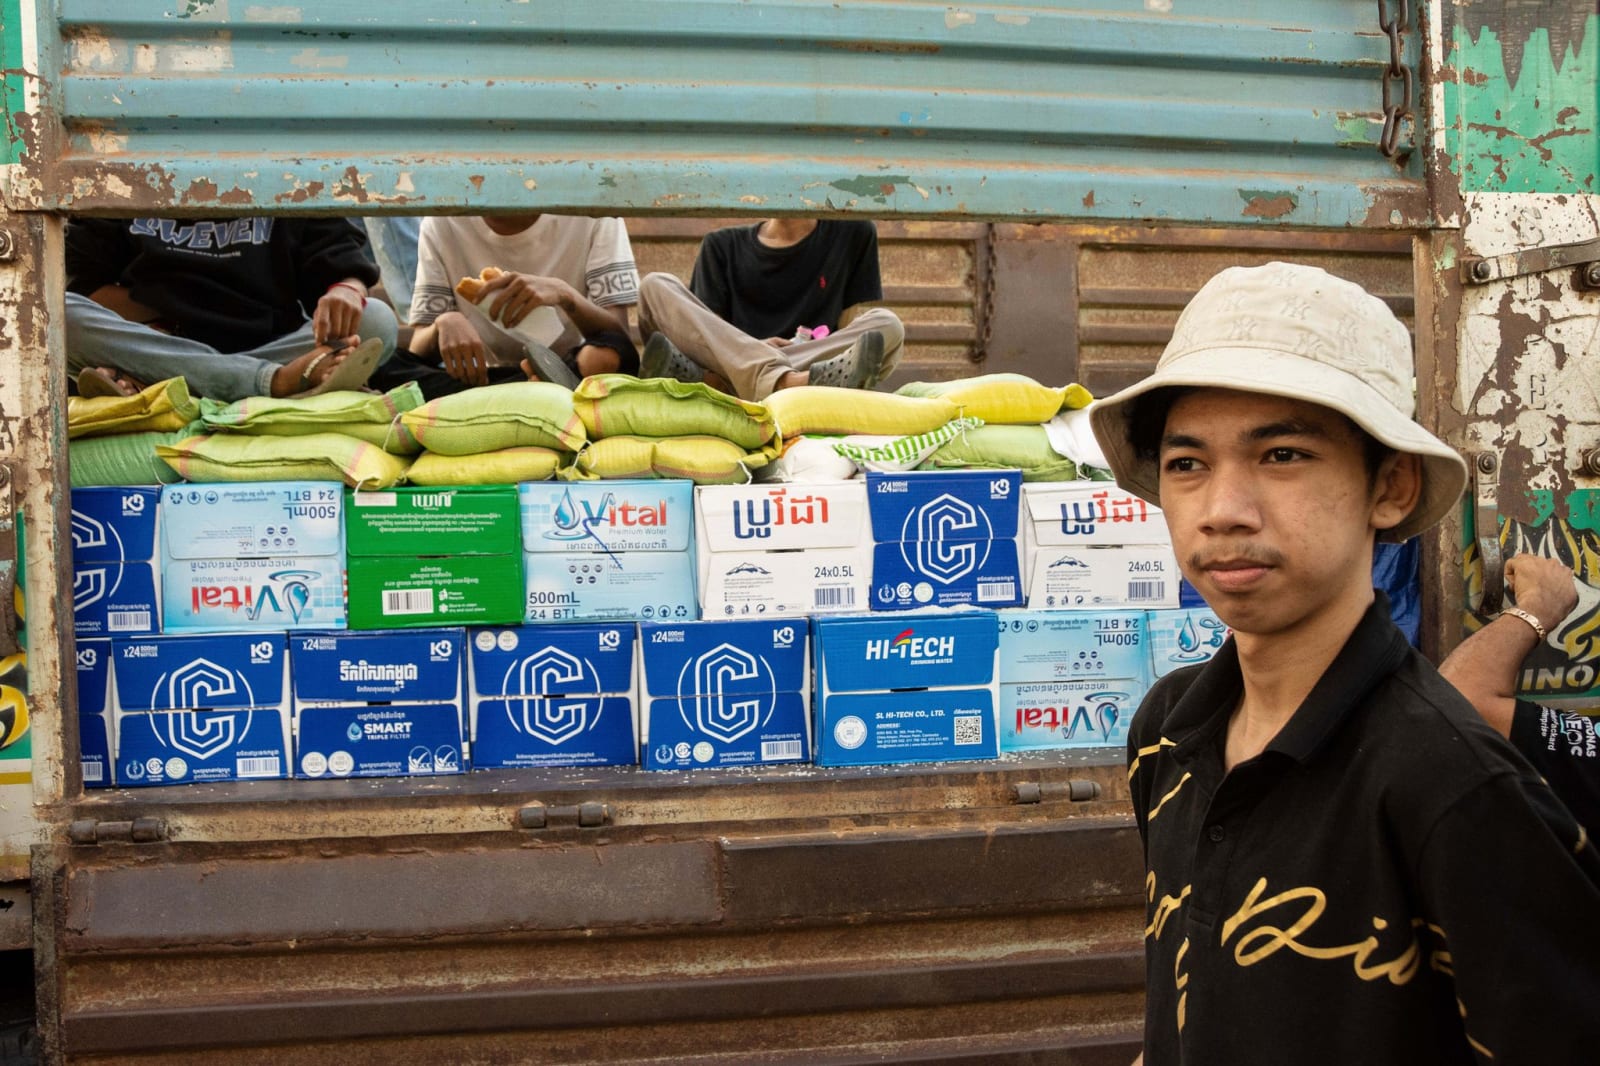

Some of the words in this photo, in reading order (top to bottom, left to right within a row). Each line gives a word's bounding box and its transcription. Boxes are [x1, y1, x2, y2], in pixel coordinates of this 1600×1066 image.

[877, 481, 892, 493] x24
[283, 490, 312, 501] BTL
[318, 490, 335, 501] 24
[282, 504, 336, 519] 500mL
[580, 492, 667, 527] Vital
[814, 566, 854, 578] 24x0.5L
[1128, 561, 1165, 572] 24x0.5L
[191, 584, 284, 621] Vital
[529, 591, 581, 604] 500mL
[530, 609, 546, 620] 24
[553, 608, 580, 619] BTL
[1095, 618, 1119, 628] BTL
[1125, 618, 1139, 628] 24
[652, 631, 668, 643] x24
[1093, 633, 1139, 646] 500mL
[303, 638, 319, 650] x24
[865, 635, 955, 660] HI-TECH
[123, 645, 140, 658] x24
[1519, 664, 1594, 692] INO
[885, 711, 914, 719] HI-TECH
[364, 722, 413, 734] SMART
[1016, 706, 1095, 739] Vital
